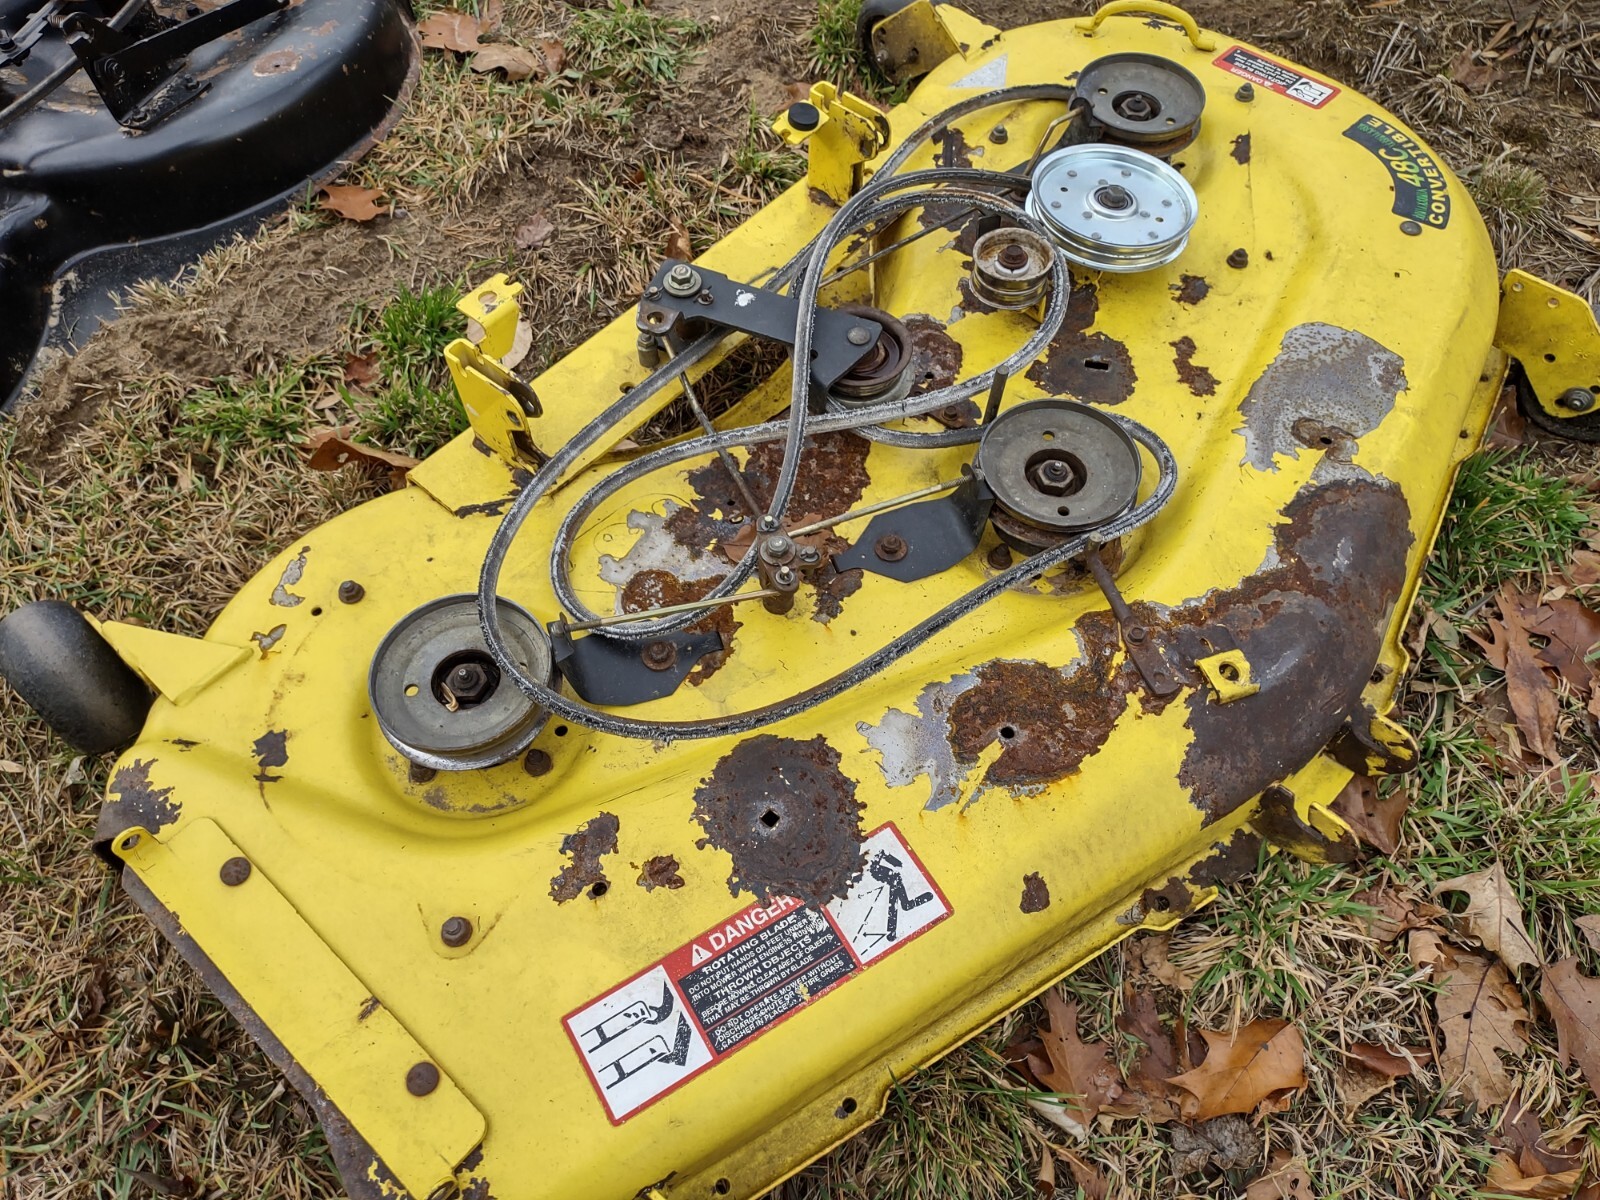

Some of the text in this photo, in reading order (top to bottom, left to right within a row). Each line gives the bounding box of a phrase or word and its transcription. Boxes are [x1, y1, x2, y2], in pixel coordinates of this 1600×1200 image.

[1230, 66, 1263, 85] DANGER
[1366, 117, 1446, 225] CONVERTIBLE
[1378, 148, 1425, 188] 48C
[702, 914, 797, 975] ROTATING BLADE
[708, 893, 795, 952] DANGER
[688, 984, 701, 995] DO
[700, 974, 716, 987] NOT
[716, 965, 732, 978] PUT
[730, 950, 756, 969] HANDS
[755, 943, 767, 954] OR
[766, 932, 785, 947] FEET
[784, 918, 809, 936] UNDER
[691, 987, 711, 1001] INTO
[709, 970, 738, 991] MOWER
[737, 957, 759, 974] WHEN
[758, 941, 785, 961] ENGINE
[701, 997, 729, 1018] BEFORE
[755, 967, 779, 984] CLEAR
[777, 956, 796, 971] AREA
[794, 950, 805, 960] OF
[713, 935, 812, 1000] THROWN OBJECTS
[705, 954, 815, 1025] THAT MAY BE THROWN BY BLADE
[714, 1025, 727, 1036] DO
[727, 1014, 745, 1028] NOT
[743, 992, 779, 1018] OPERATE
[778, 974, 808, 996] MOWER
[807, 954, 841, 977] WITHOUT
[717, 1012, 761, 1042] DISCHARGE
[759, 997, 784, 1016] CHUTE
[783, 990, 795, 1001] OR
[819, 959, 845, 978] GRASS
[720, 1024, 756, 1049] CATCHER
